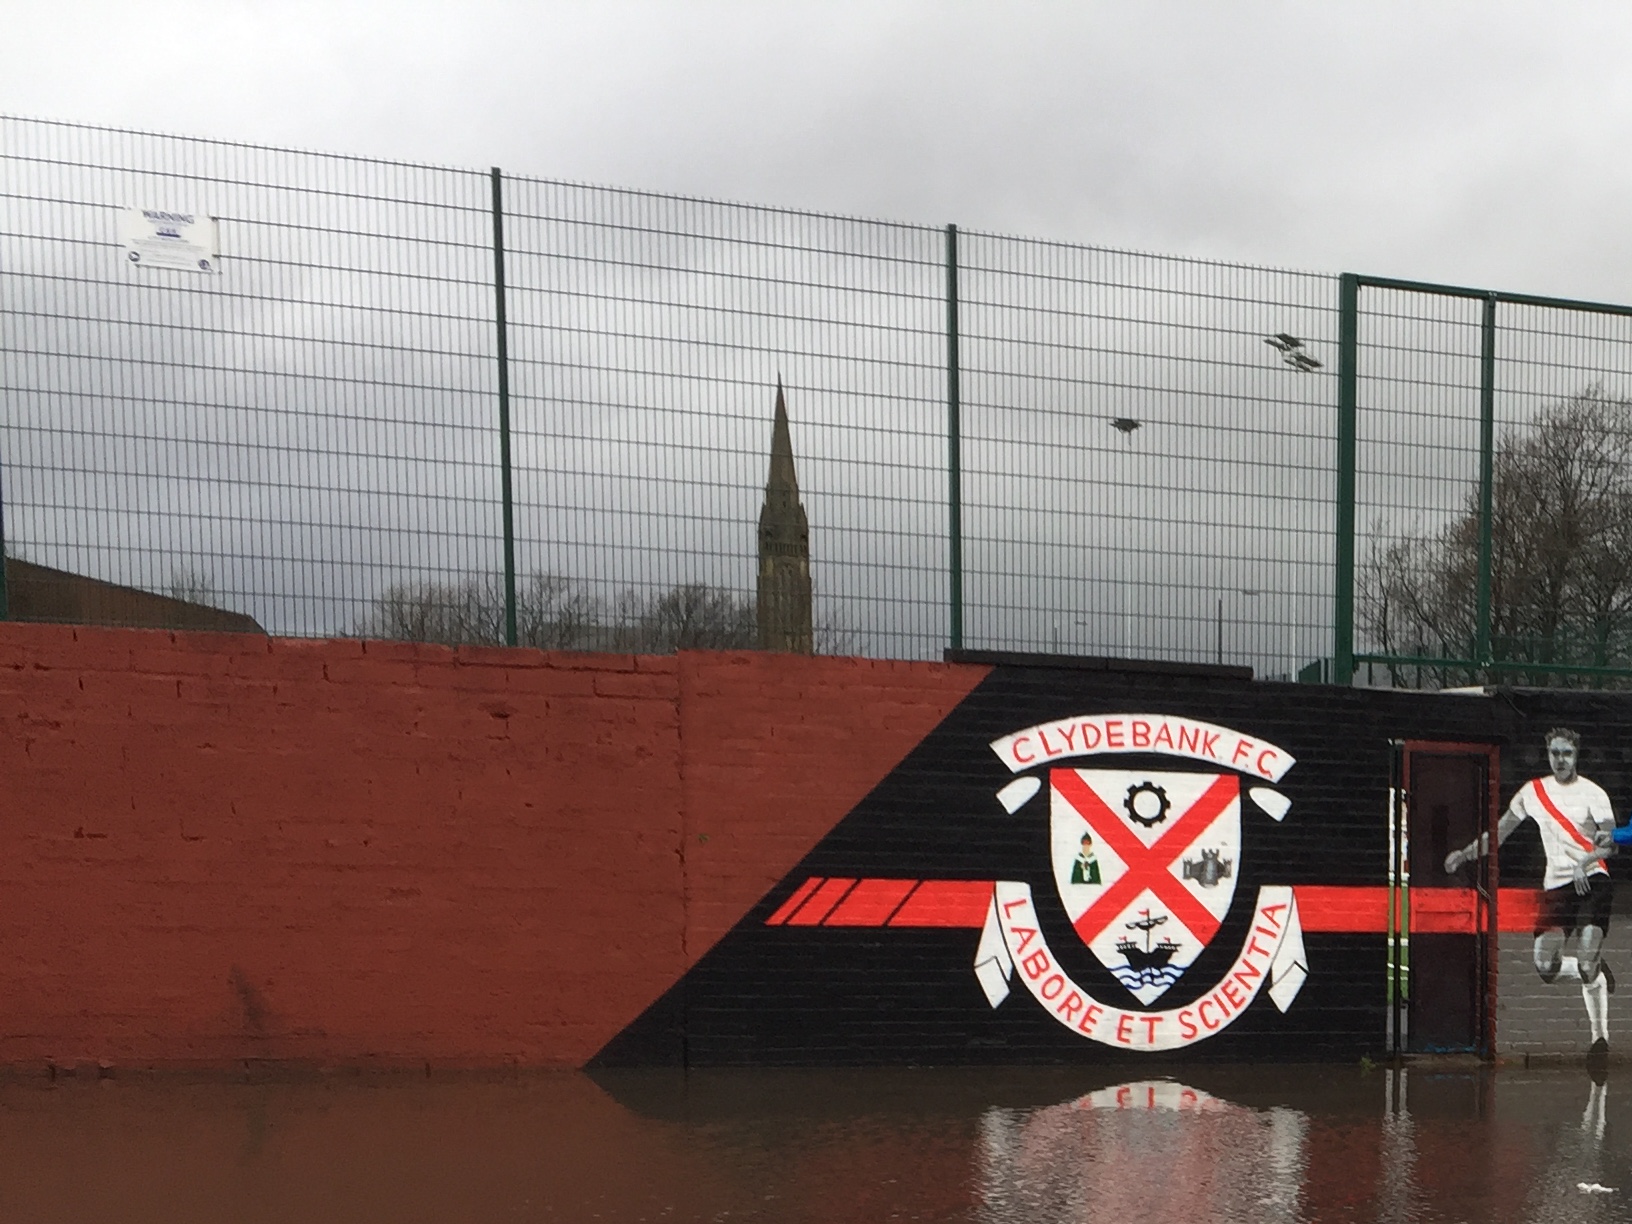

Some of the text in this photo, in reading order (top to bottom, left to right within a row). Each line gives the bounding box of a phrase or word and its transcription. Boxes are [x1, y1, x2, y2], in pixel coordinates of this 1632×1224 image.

[1012, 720, 1221, 765] CLYDEBANK
[1003, 898, 1288, 1045] LABORE ET SCIENTIA
